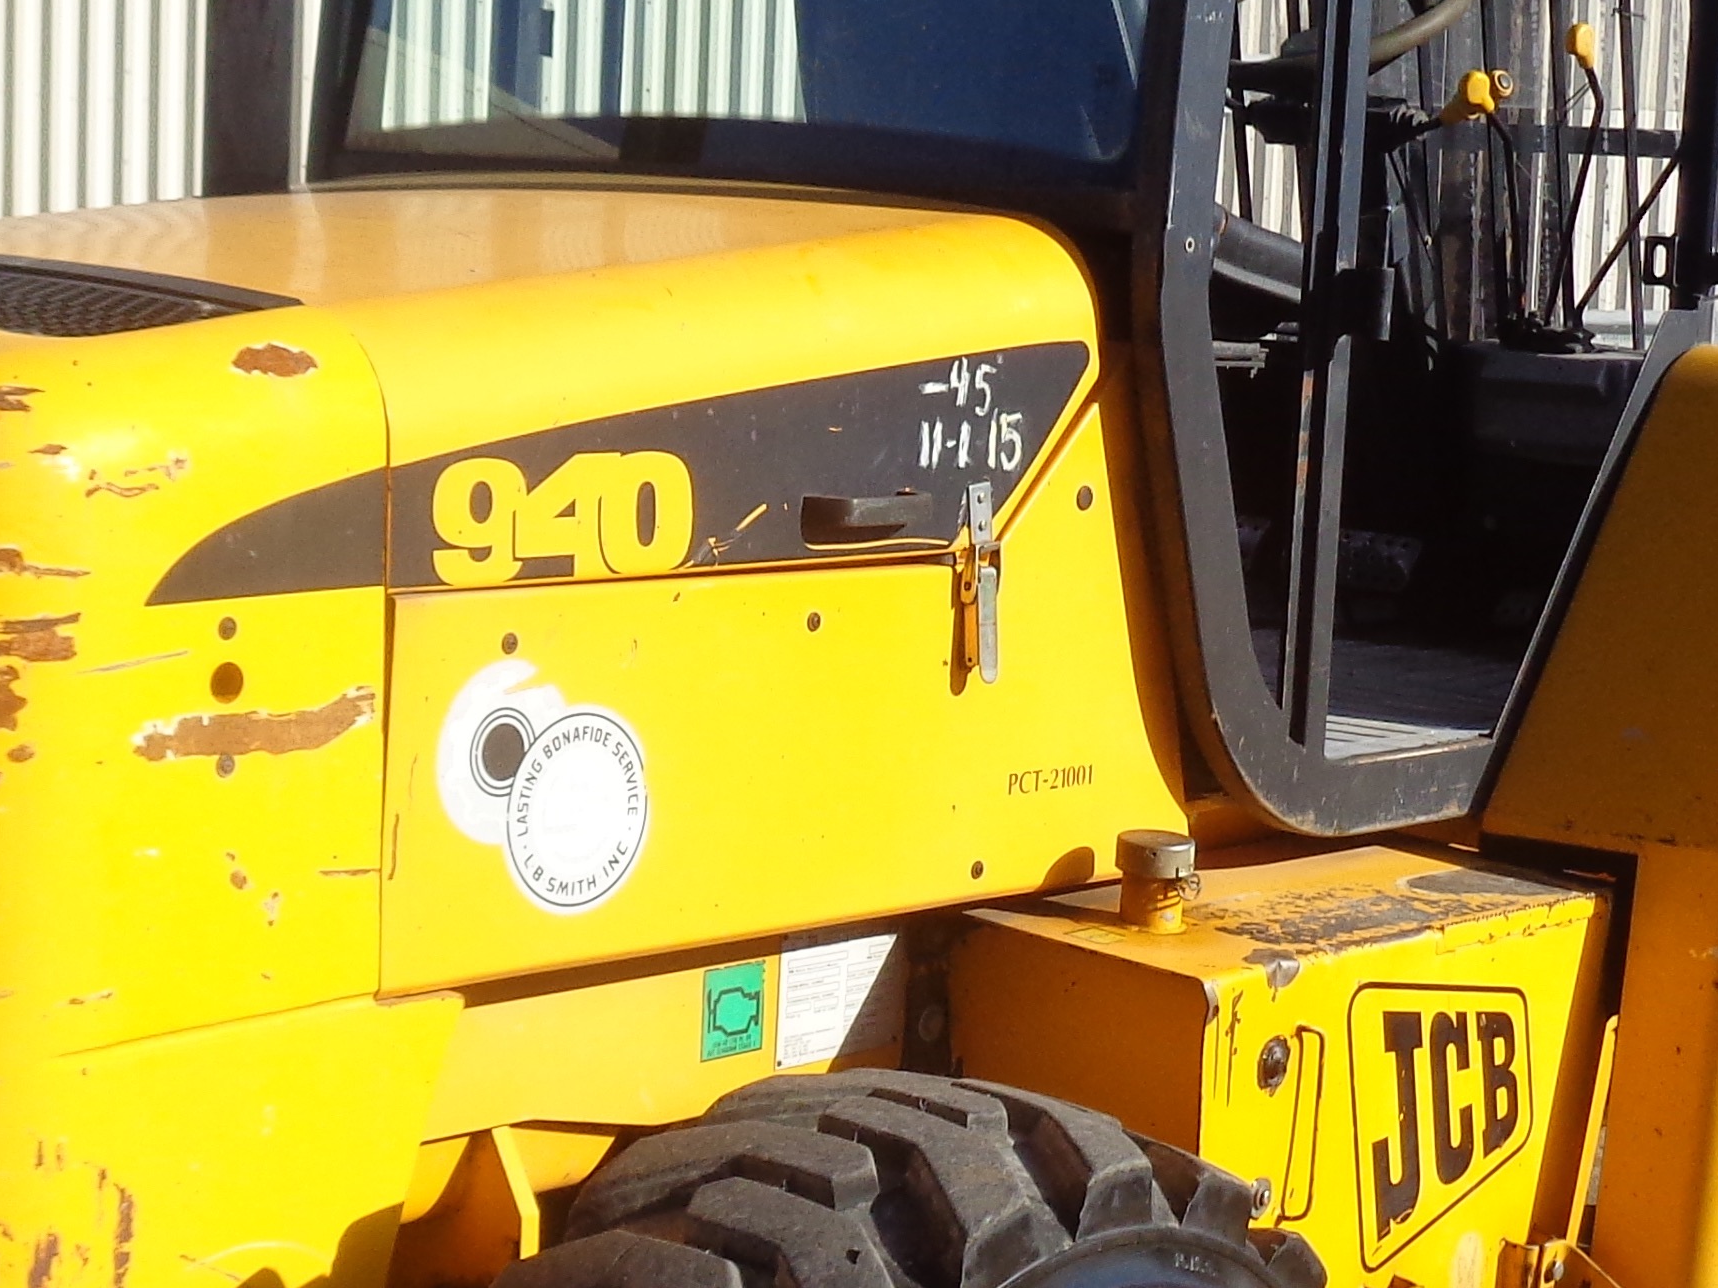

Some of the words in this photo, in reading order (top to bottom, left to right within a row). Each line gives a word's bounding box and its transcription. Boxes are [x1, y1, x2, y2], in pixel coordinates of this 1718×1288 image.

[432, 450, 695, 587] 940
[516, 758, 543, 838] LASTING
[542, 725, 613, 760] BONAFIDE
[612, 741, 639, 817] SERVICE
[1007, 763, 1093, 795] PCT-21001
[601, 840, 629, 878] INC
[1372, 1010, 1520, 1244] JCB
